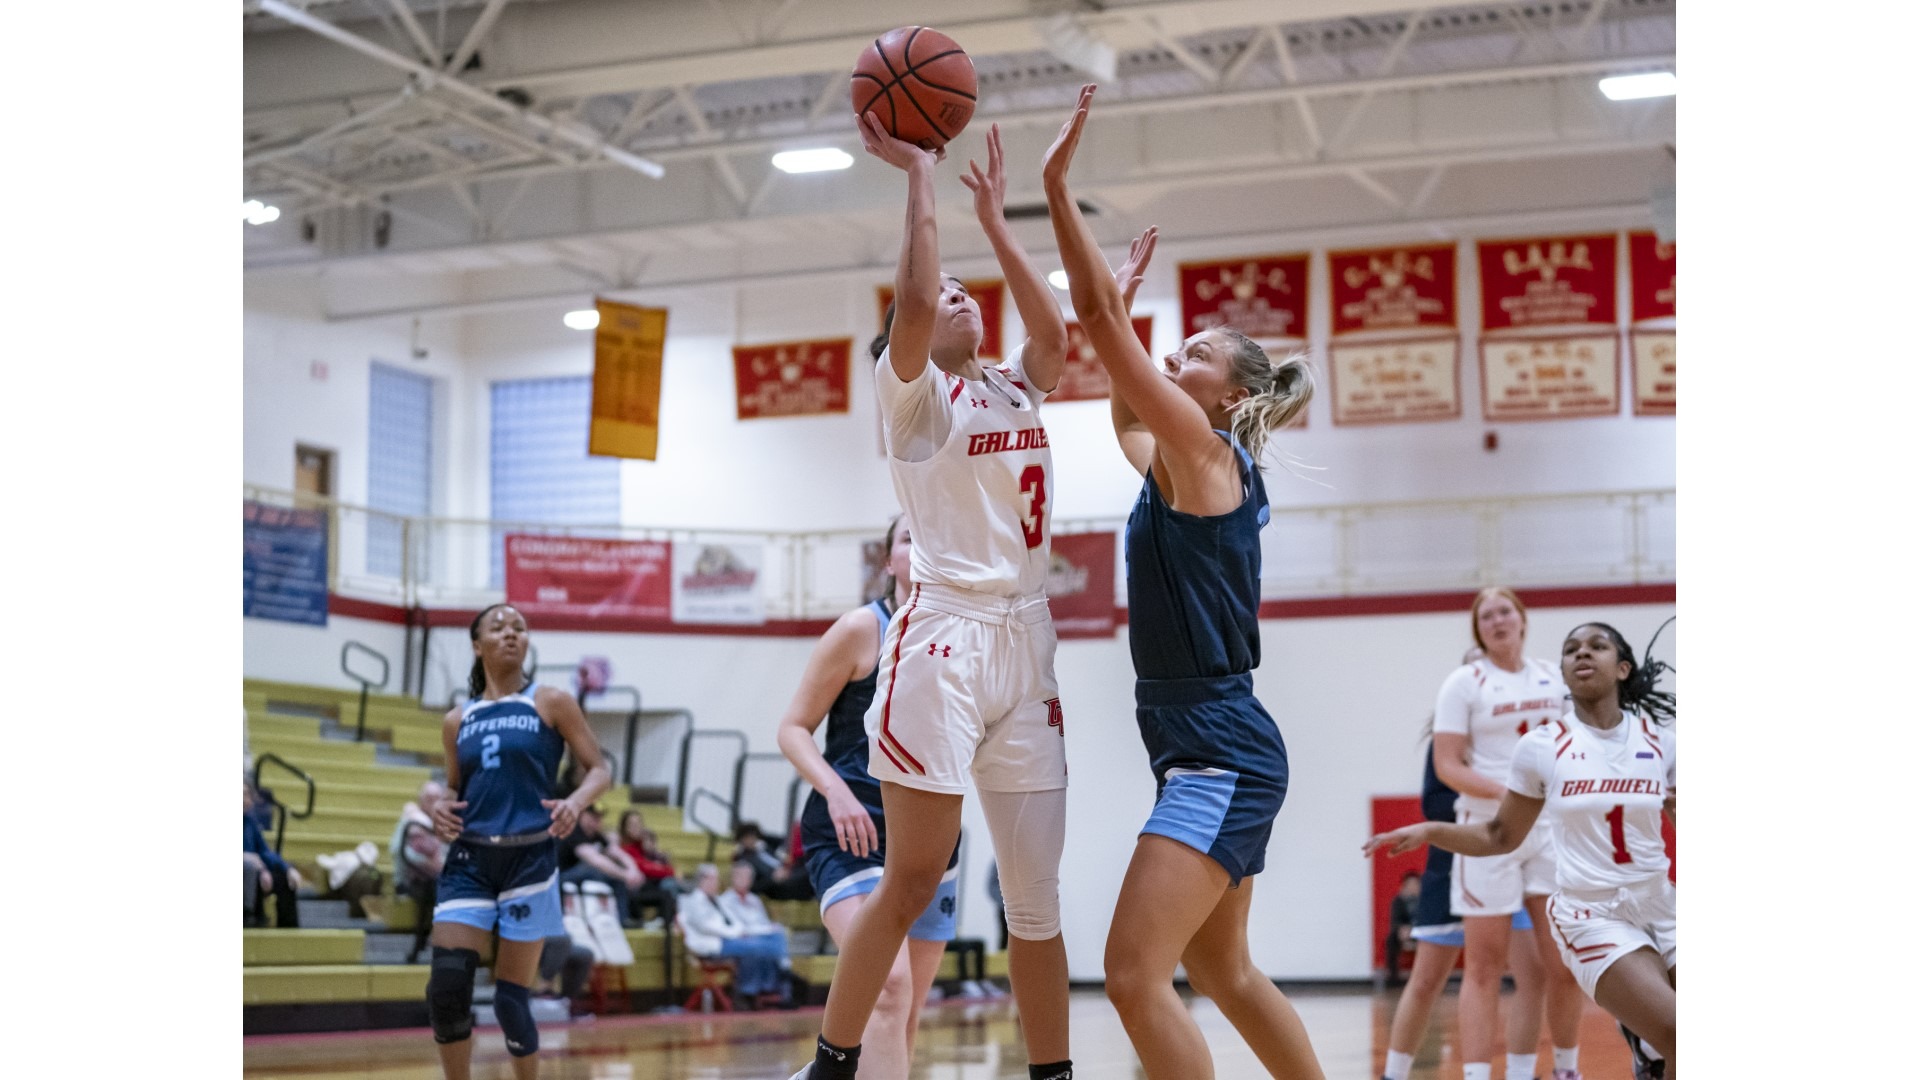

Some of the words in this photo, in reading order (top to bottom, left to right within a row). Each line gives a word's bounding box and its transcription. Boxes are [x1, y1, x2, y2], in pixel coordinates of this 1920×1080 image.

[1018, 463, 1046, 551] 3
[481, 733, 501, 770] 2
[1605, 803, 1634, 865] 1
